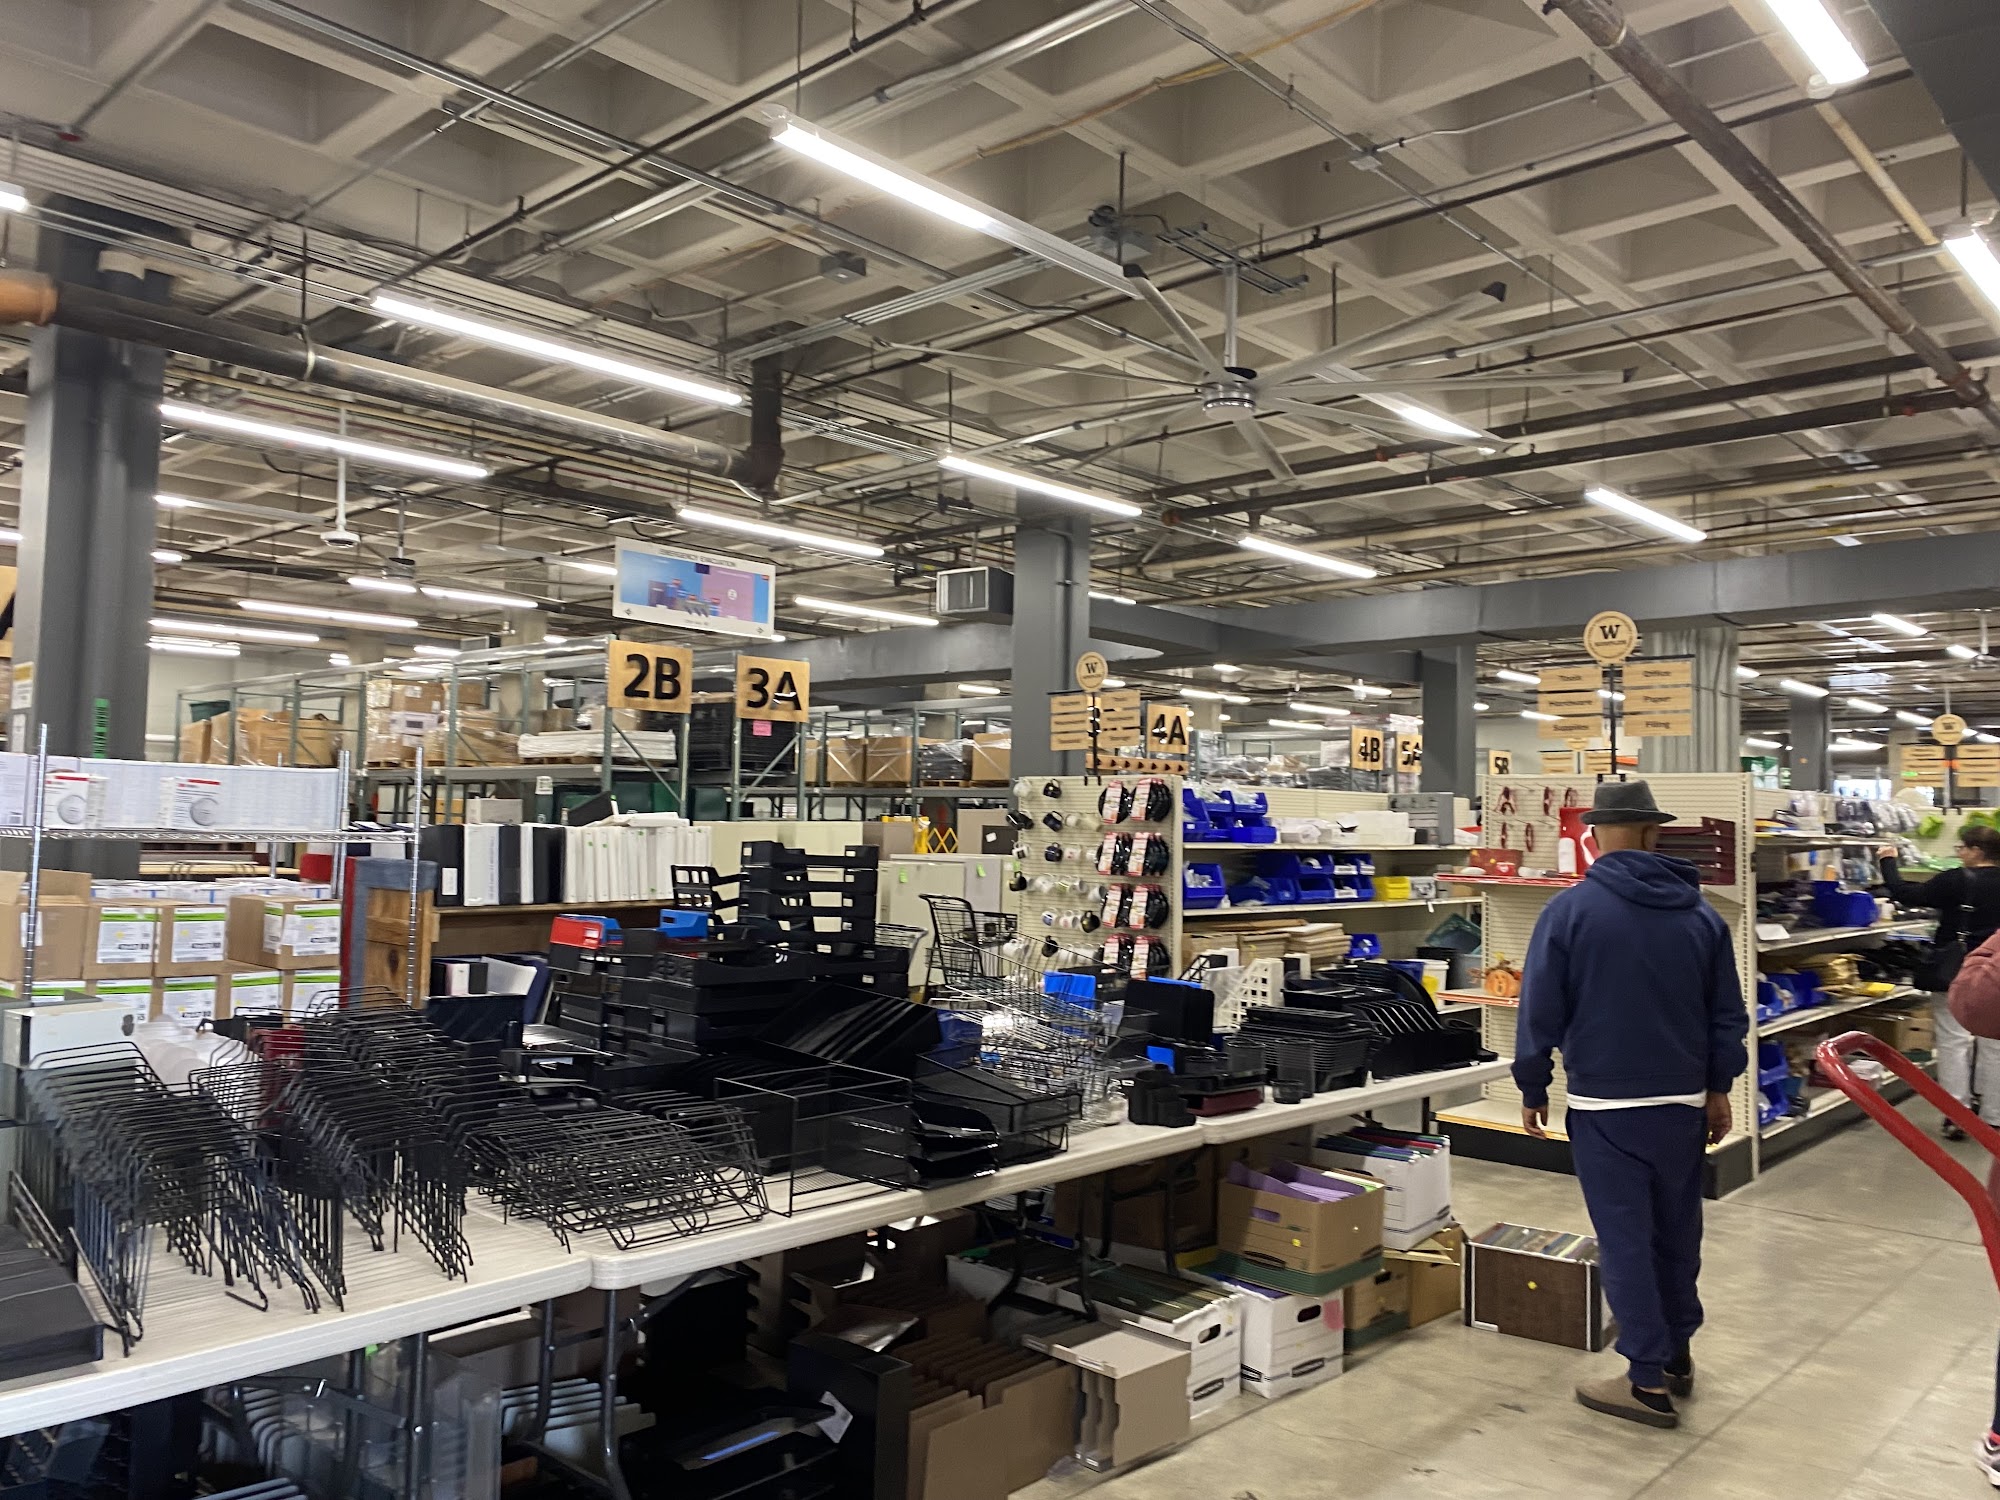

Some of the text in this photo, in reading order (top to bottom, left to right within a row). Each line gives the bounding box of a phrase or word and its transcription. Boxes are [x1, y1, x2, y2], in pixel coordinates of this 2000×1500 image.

[1600, 624, 1621, 640] W
[624, 653, 681, 700] 2B
[1085, 662, 1098, 673] W
[746, 667, 802, 711] 3A
[1151, 713, 1187, 746] 4A
[1359, 736, 1380, 763] 4B
[1401, 741, 1422, 766] 5A
